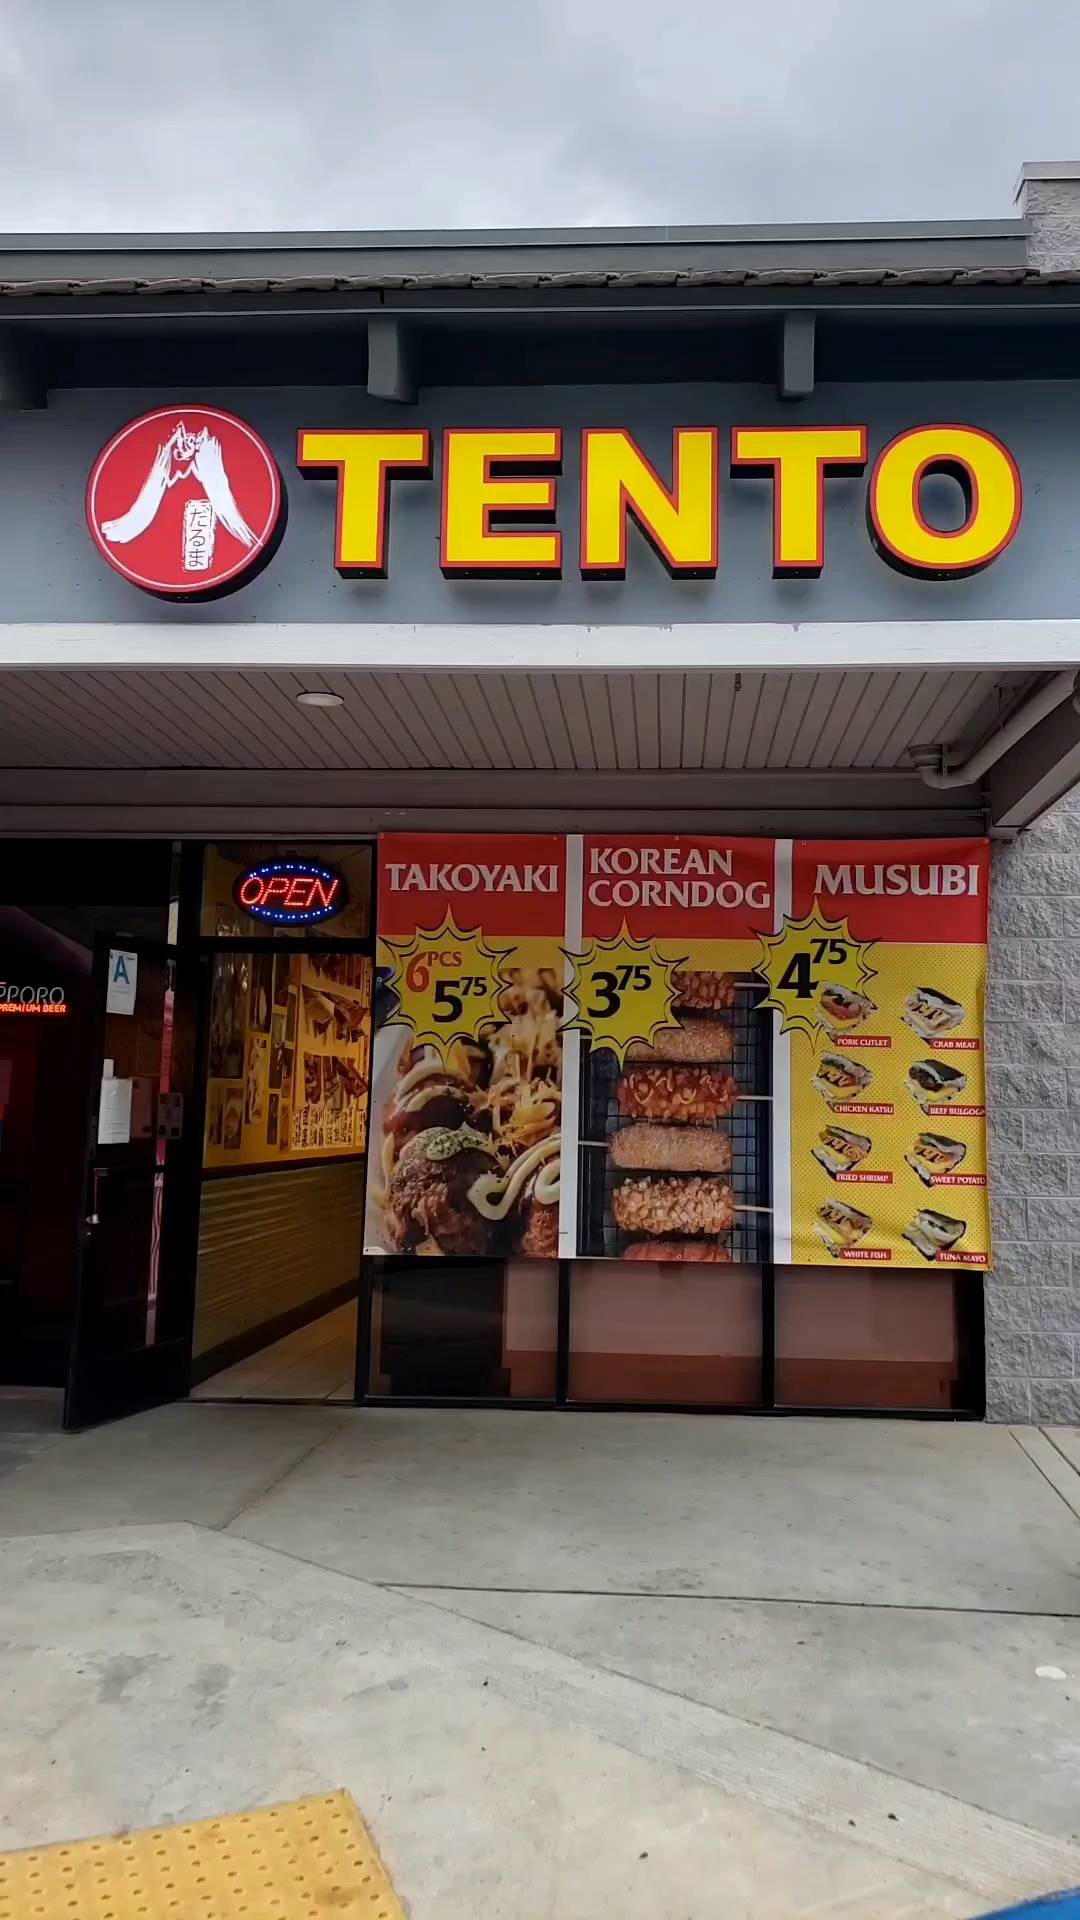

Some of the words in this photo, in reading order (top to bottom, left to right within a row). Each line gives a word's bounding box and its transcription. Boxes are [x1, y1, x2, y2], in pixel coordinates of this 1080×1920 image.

[296, 422, 1022, 576] TENTO
[188, 506, 211, 568] だるま
[589, 847, 733, 876] KOREAN
[240, 876, 339, 907] OPEN
[384, 863, 560, 893] TAKOYAKI
[813, 864, 980, 896] MUSUBI
[588, 879, 771, 909] CORNDOG
[113, 955, 130, 985] A
[42, 1004, 67, 1013] BEER
[837, 1038, 859, 1046] PORK
[860, 1039, 889, 1047] CUTLET
[933, 1040, 954, 1048] CRAB
[955, 1041, 976, 1049] MEAT
[834, 1105, 868, 1113] CHICKEN
[869, 1105, 893, 1113] KATSU
[930, 1176, 956, 1184] SWEET
[957, 1177, 986, 1185] POTATO
[843, 1250, 869, 1258] WHITE
[870, 1251, 887, 1259] FISH
[940, 1252, 962, 1261] TUNA
[962, 1255, 986, 1263] MAYO
